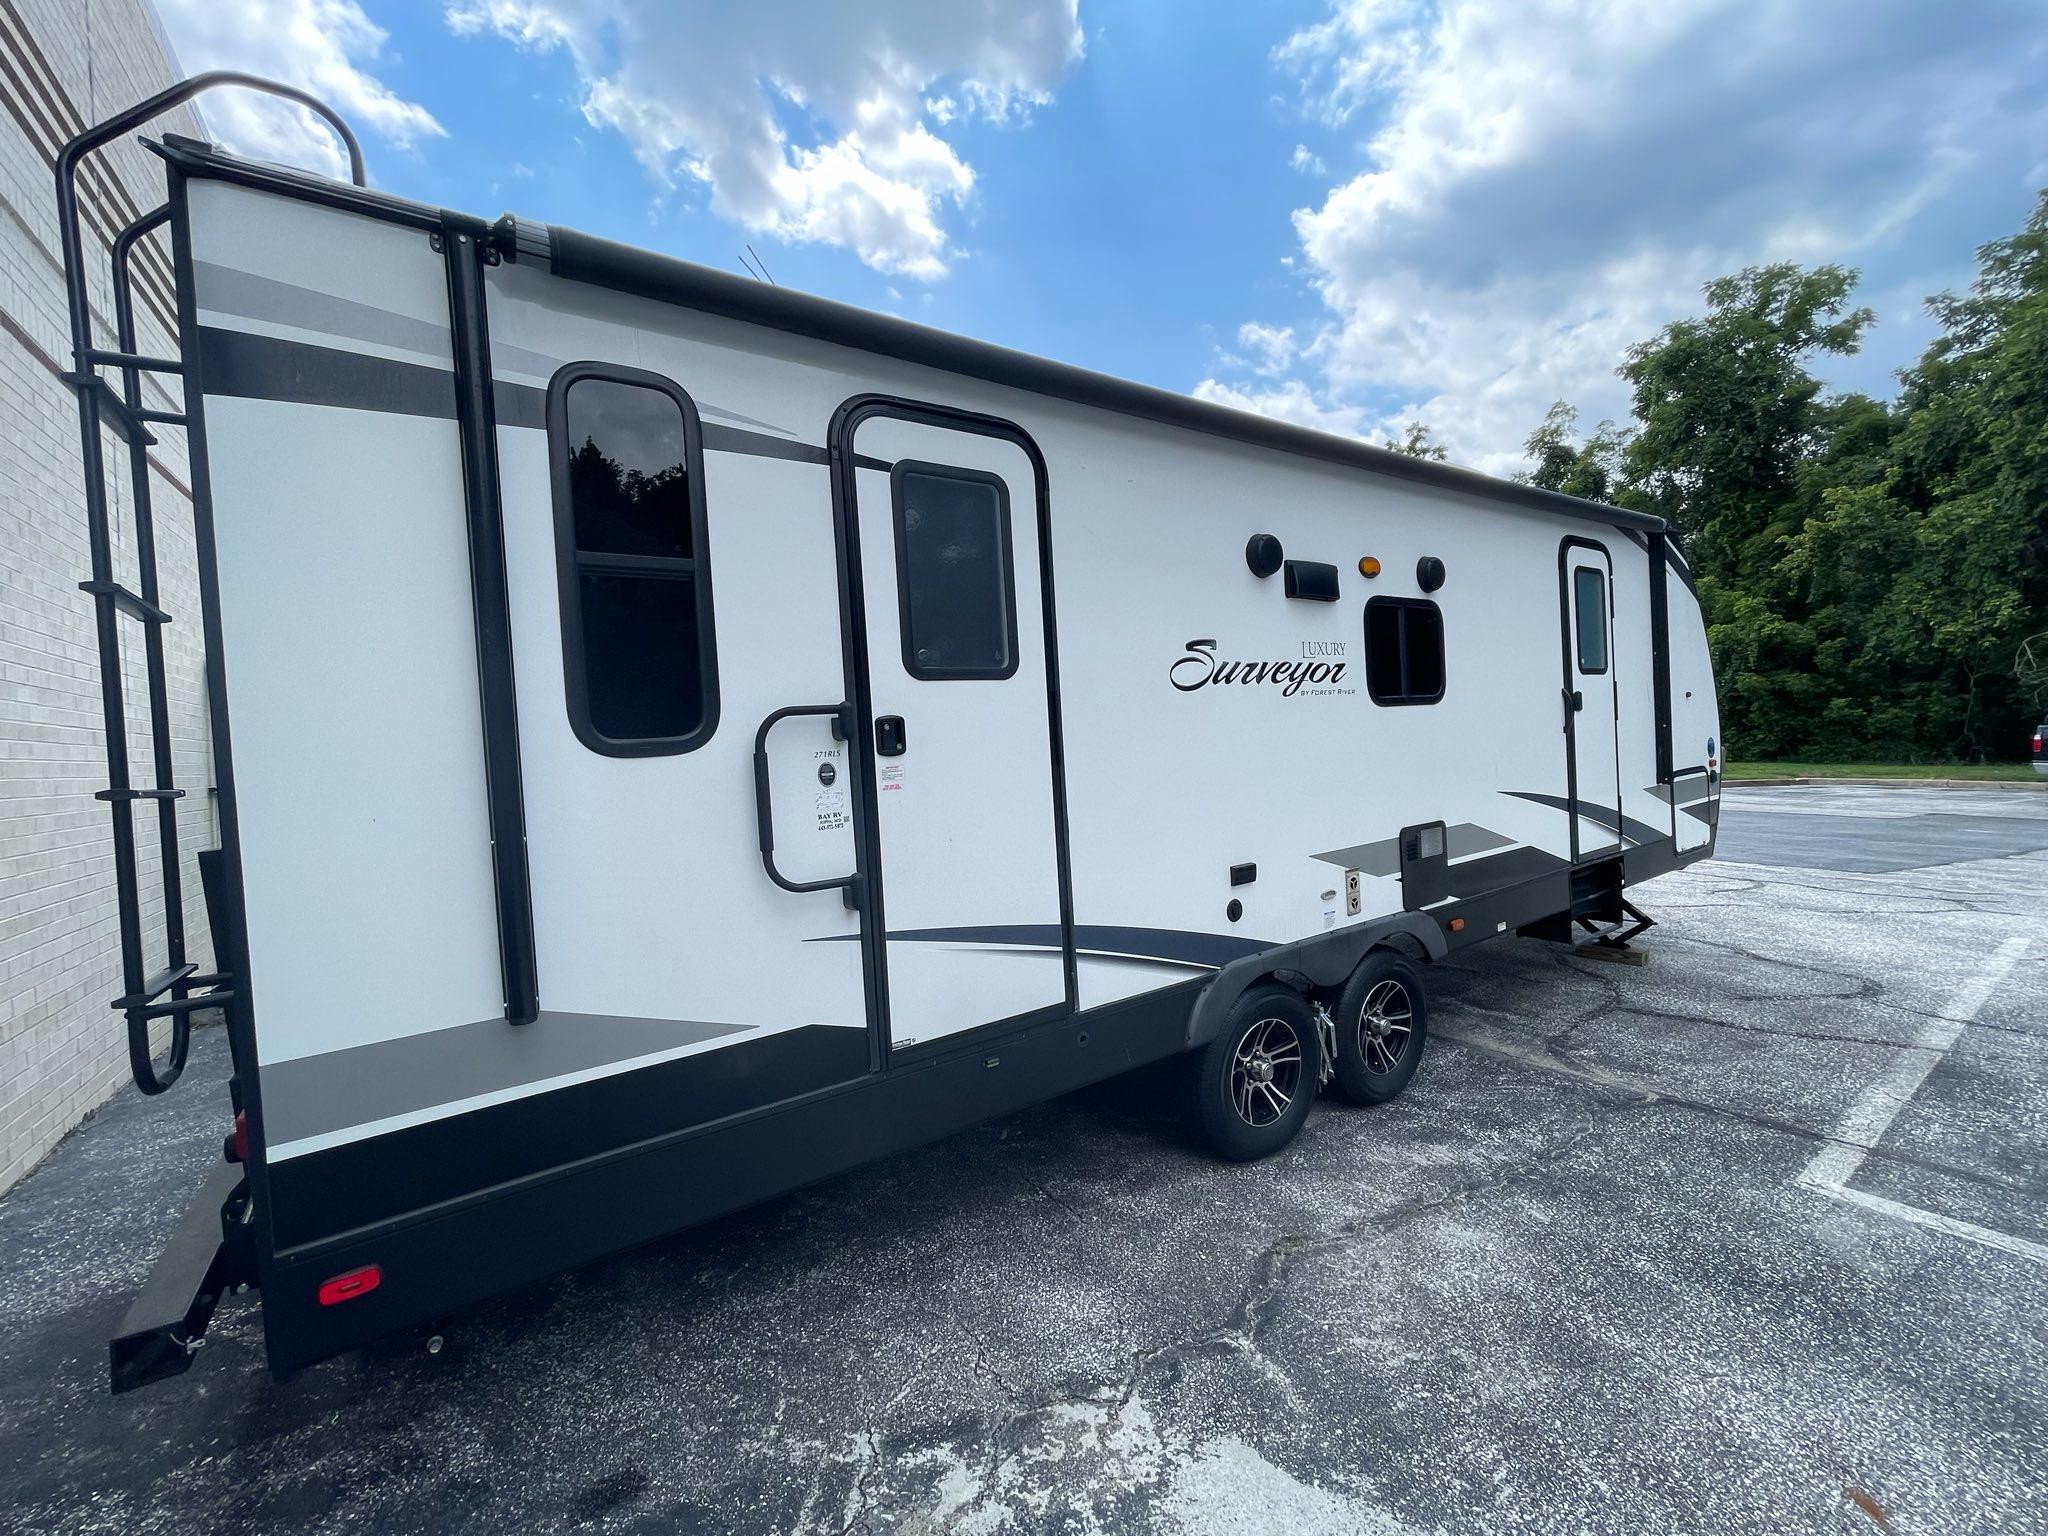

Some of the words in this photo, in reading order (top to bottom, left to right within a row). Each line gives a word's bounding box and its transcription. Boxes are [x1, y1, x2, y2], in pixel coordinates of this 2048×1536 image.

[1301, 641, 1346, 658] LUXURY
[1169, 638, 1347, 697] Surveyor
[1310, 688, 1335, 696] FOREST
[814, 750, 841, 758] 271RLS
